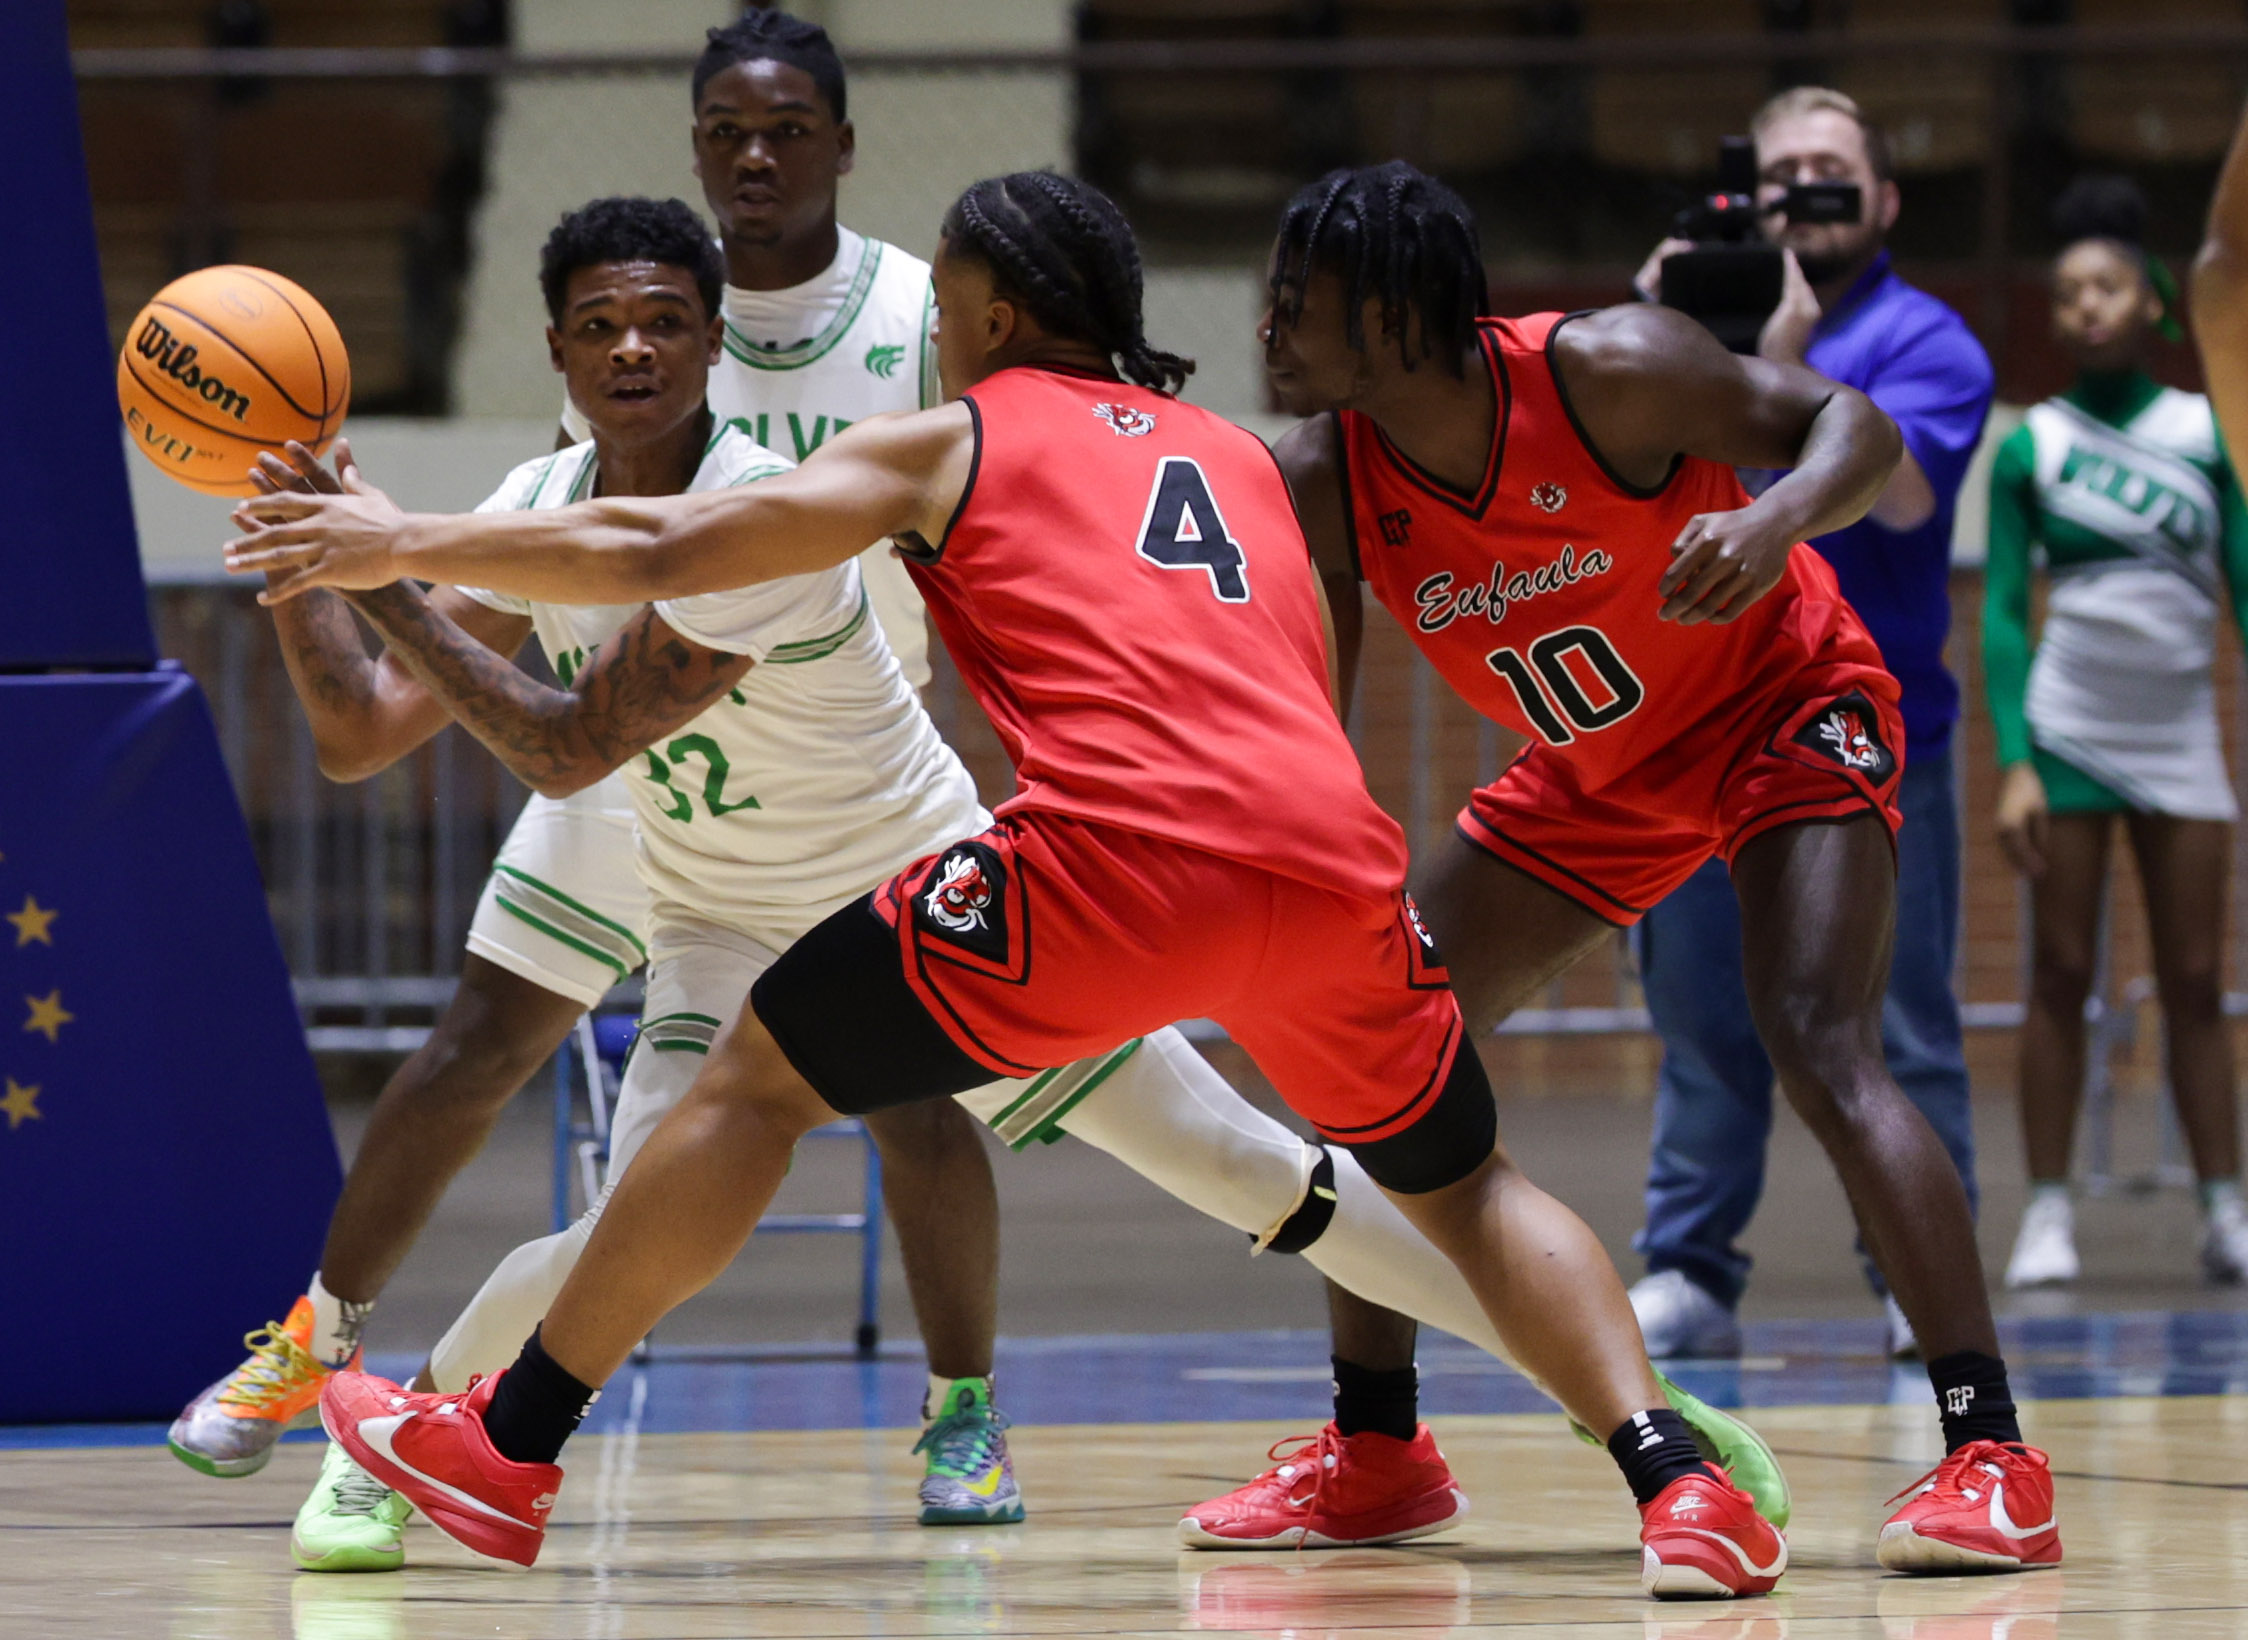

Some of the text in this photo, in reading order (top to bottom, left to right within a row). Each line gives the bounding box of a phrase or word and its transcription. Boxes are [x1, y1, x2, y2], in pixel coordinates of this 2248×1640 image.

[136, 314, 250, 421] Wilson
[1135, 456, 1250, 604] 4
[1414, 543, 1613, 632] Eufaula
[1485, 625, 1645, 746] 10
[640, 732, 762, 824] 32
[1672, 1513, 1699, 1522] AIR
